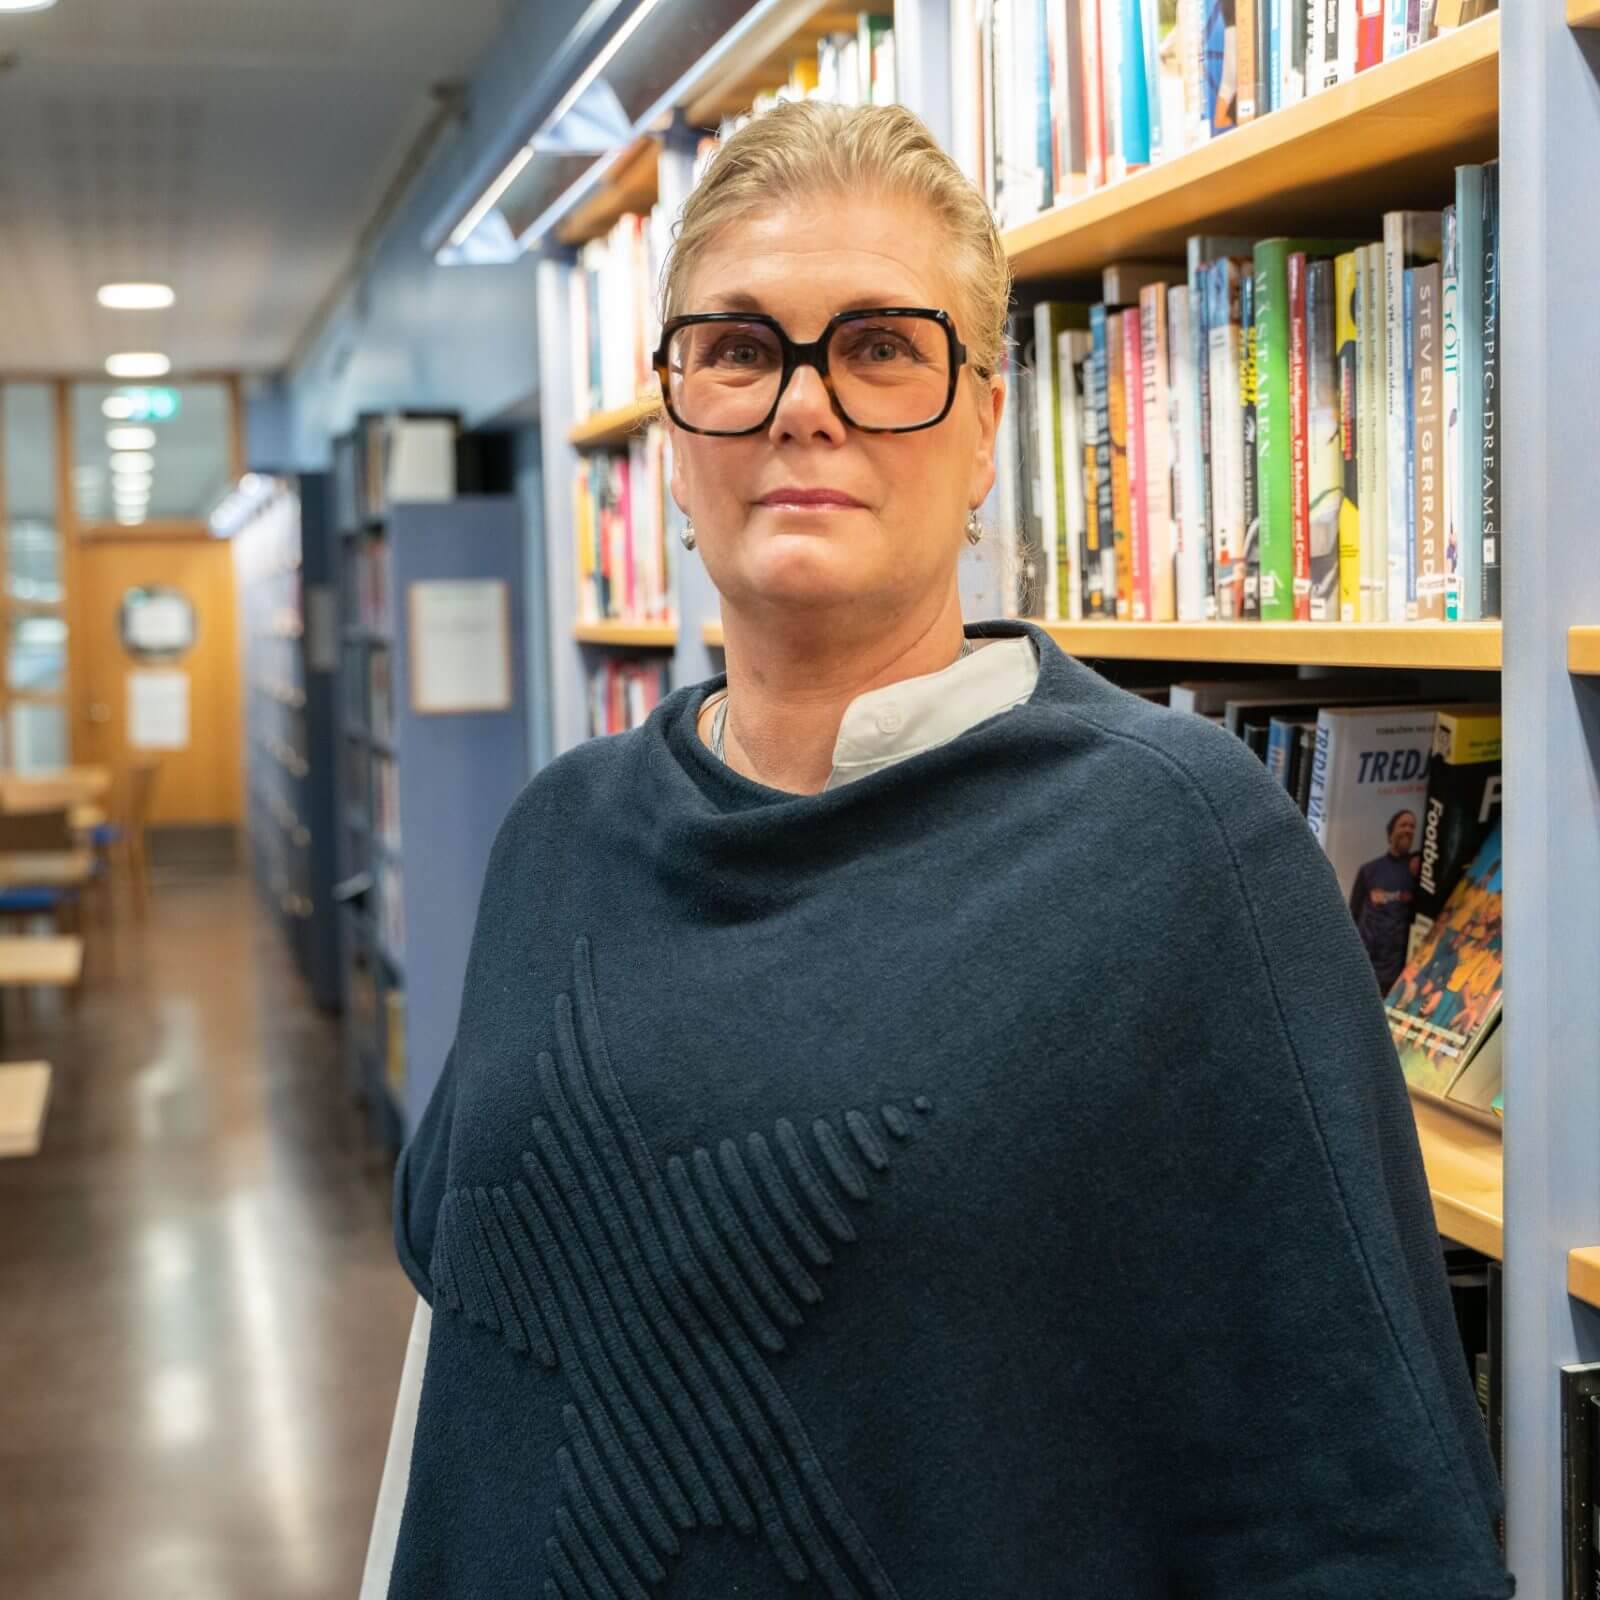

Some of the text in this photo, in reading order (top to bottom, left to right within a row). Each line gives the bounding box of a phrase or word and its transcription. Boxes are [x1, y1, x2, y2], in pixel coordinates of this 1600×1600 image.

[1293, 317, 1304, 364] Football
[1419, 285, 1433, 406] STEVEN
[1483, 251, 1496, 533] OLYMPIC DREAMS
[1295, 519, 1305, 541] and
[1421, 430, 1435, 577] GERRARD
[1307, 726, 1329, 834] TREDJE VÄG
[1357, 748, 1430, 785] TREDJ
[1418, 797, 1444, 896] Football
